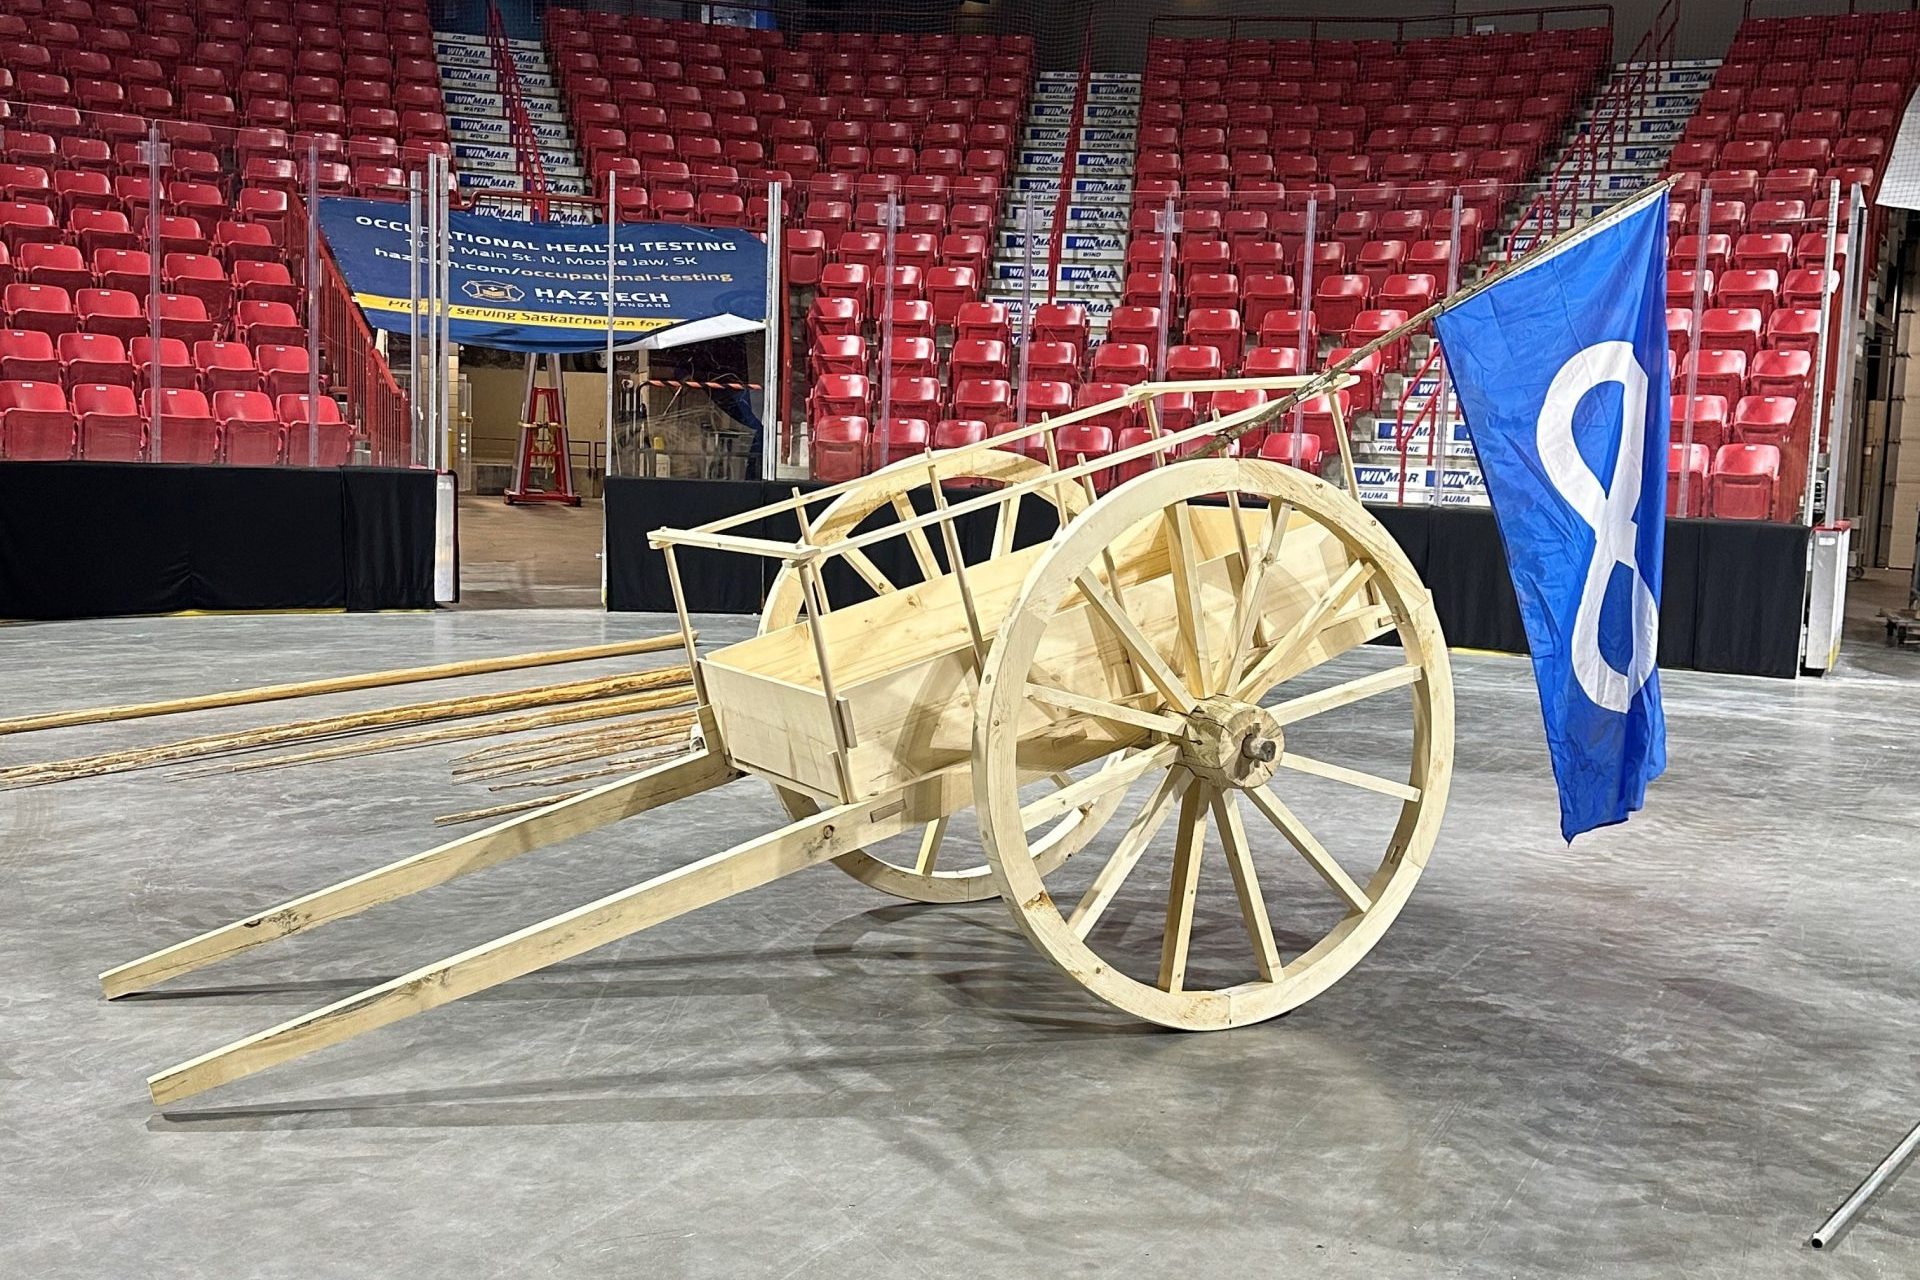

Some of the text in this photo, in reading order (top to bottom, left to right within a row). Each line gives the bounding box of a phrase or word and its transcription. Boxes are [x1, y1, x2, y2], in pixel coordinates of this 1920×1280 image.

[446, 46, 486, 58] WINMAR
[450, 68, 490, 81] WINMAR
[1680, 73, 1712, 82] WINMA
[1047, 85, 1077, 93] WINMA
[1100, 86, 1136, 94] WINMAR
[454, 94, 496, 106] WINMAR
[1665, 98, 1700, 108] WINMA
[1043, 107, 1072, 116] WINMA
[1096, 108, 1134, 117] WINMAR
[460, 120, 503, 132] WINMAR
[1650, 122, 1686, 131] WINMA
[1040, 130, 1070, 139] WINMA
[1094, 132, 1133, 140] WINMAR
[466, 148, 510, 160] WINMAR
[1032, 154, 1064, 164] WINMA
[1636, 150, 1671, 159] WINMA
[1087, 156, 1127, 166] WINMAR
[470, 176, 516, 188] WINMAR
[1028, 182, 1061, 190] WINMA
[1085, 182, 1127, 192] WINMAR
[474, 206, 522, 220] WINMAR
[549, 210, 587, 224] INMAR
[1080, 210, 1123, 220] WINMAR
[640, 242, 736, 252] TESTING
[1015, 238, 1050, 247] WNMA
[1075, 238, 1120, 248] WINMAR
[462, 246, 506, 260] Main
[512, 253, 536, 262] St.
[566, 257, 628, 266] Mooe
[673, 257, 698, 265] SK
[1009, 268, 1049, 278] WIMA
[1070, 269, 1116, 280] WINMAR
[534, 288, 669, 302] HAZTECH
[457, 308, 516, 321] serving
[520, 310, 635, 327] Saskatchean
[1360, 470, 1419, 482] WINMR
[1442, 473, 1485, 486] WINMA
[1428, 494, 1471, 503] TAUMA
